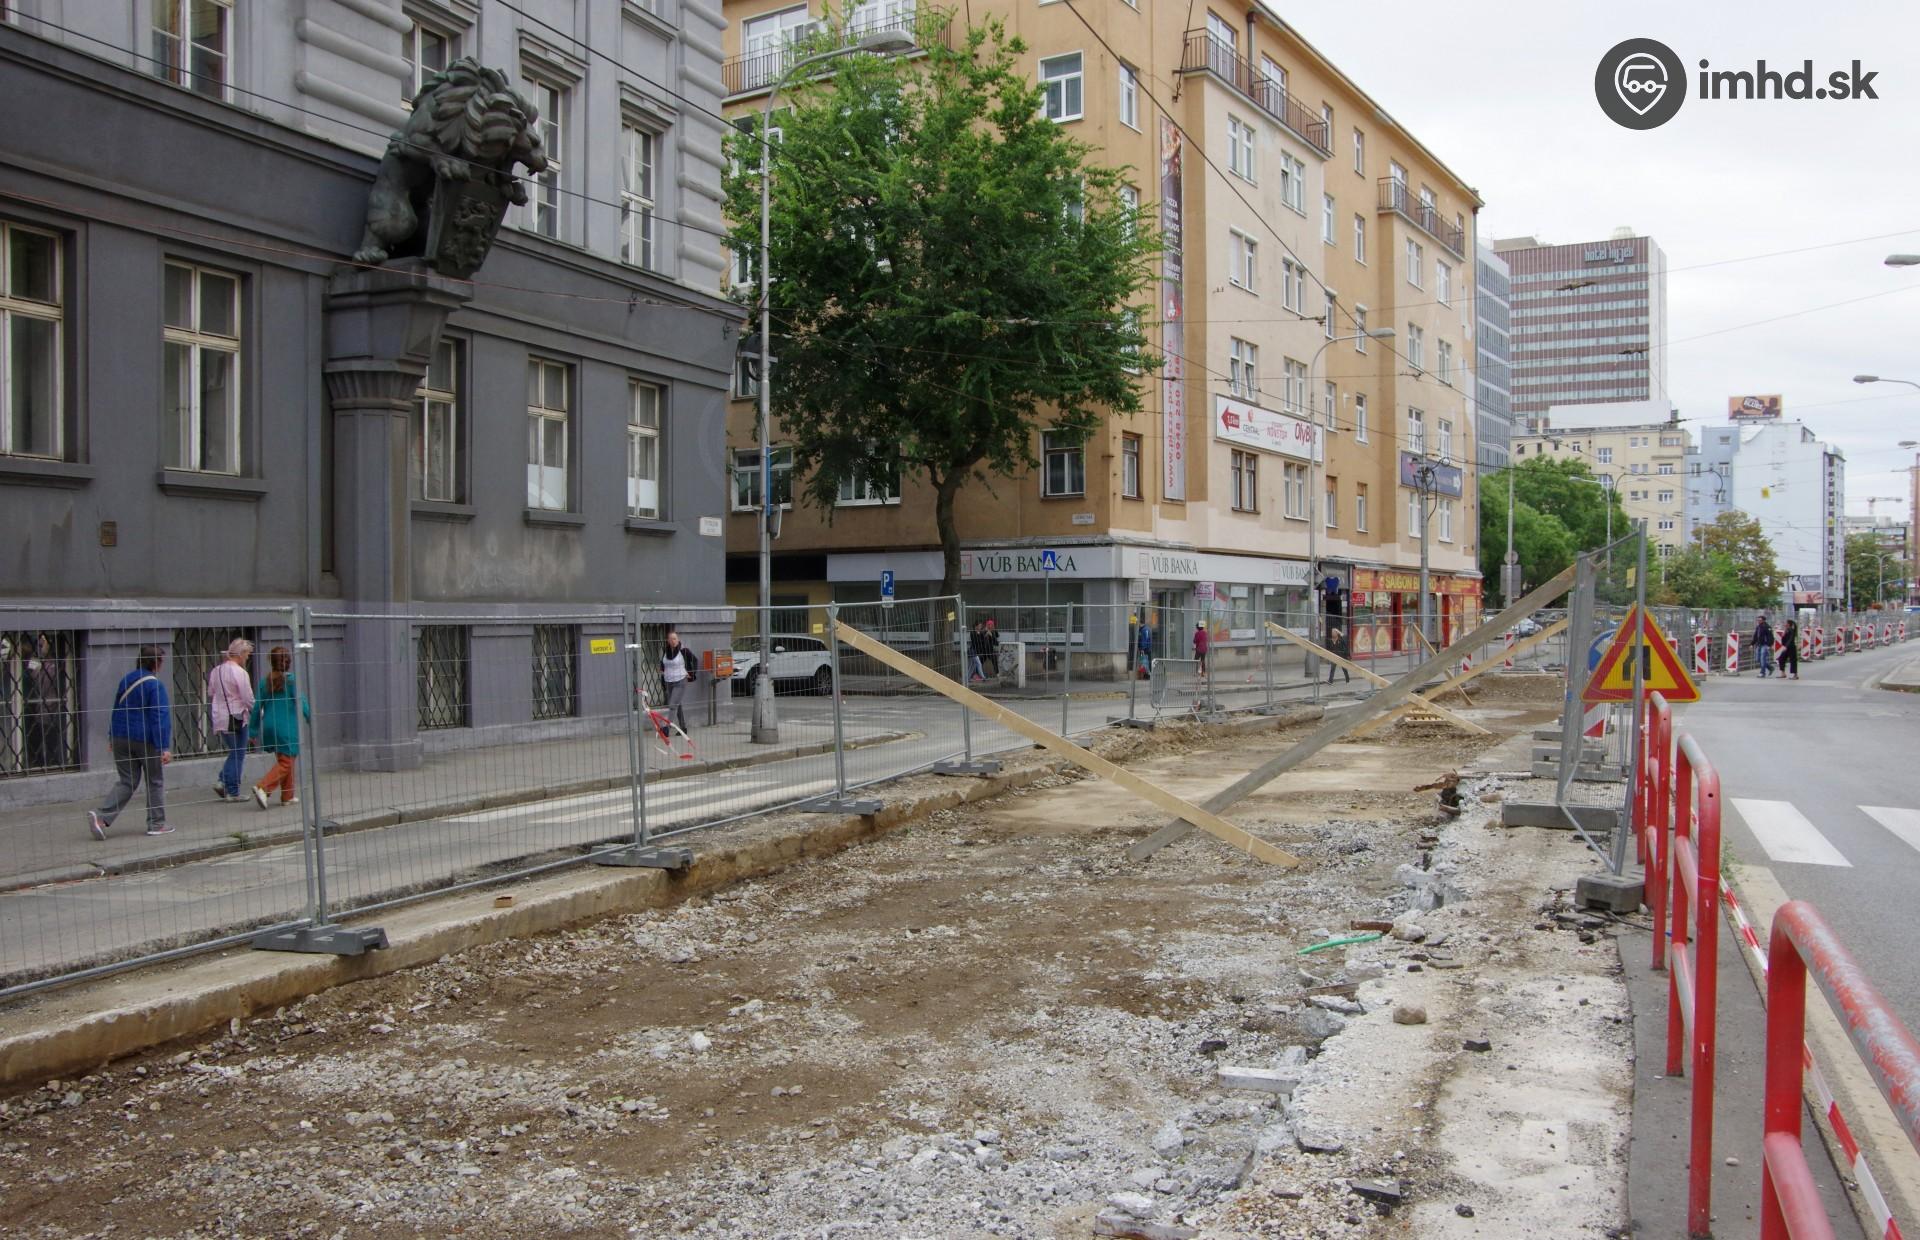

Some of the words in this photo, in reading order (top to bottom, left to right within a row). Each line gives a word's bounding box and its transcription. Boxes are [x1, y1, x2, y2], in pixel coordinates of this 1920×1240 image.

[1295, 422, 1317, 445] OlyBt
[978, 552, 1013, 573] VÚB
[1152, 554, 1169, 573] VÚB
[1171, 557, 1198, 575] BANKA
[1281, 563, 1295, 579] VÚB
[883, 573, 890, 589] P
[1385, 575, 1412, 590] SAIGON
